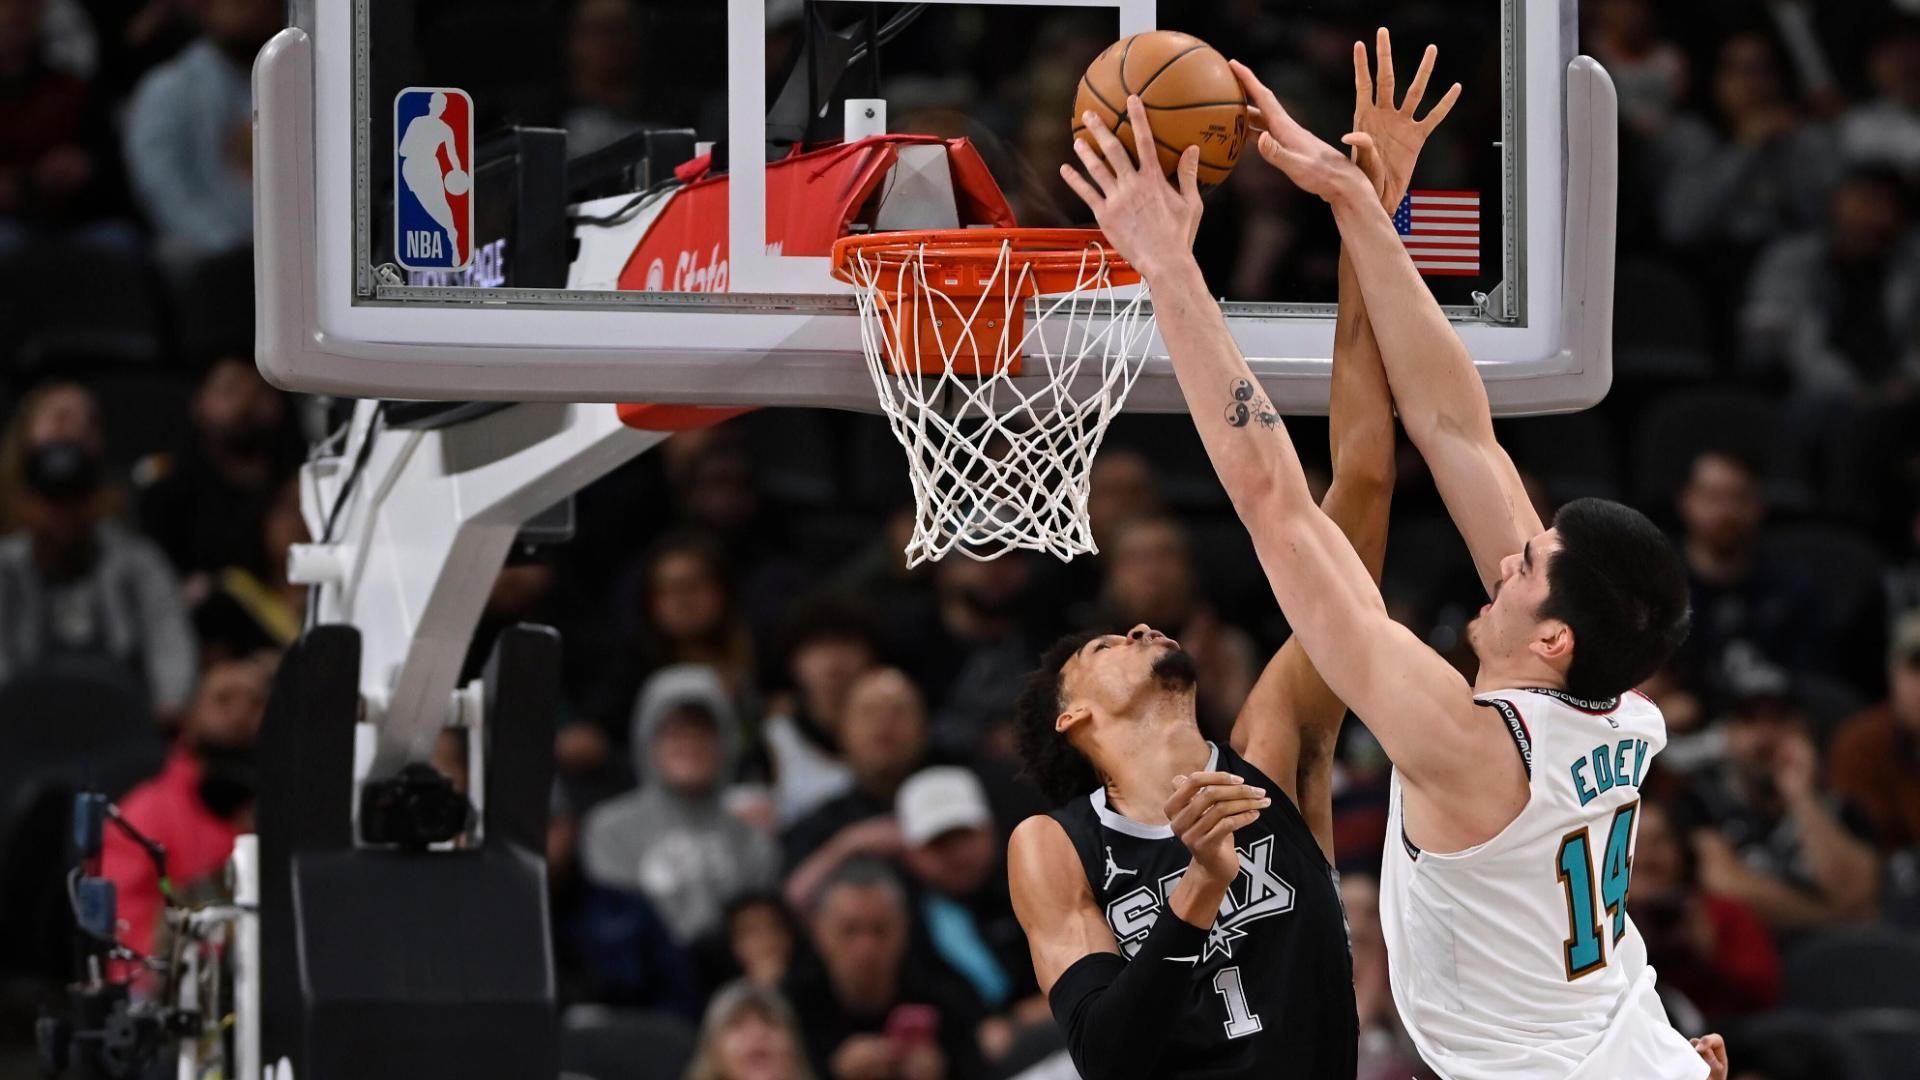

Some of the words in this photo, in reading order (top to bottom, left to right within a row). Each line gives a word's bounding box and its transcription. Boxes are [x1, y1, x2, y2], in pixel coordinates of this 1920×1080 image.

[406, 230, 443, 259] NBA
[1570, 738, 1648, 808] EDEY
[1106, 834, 1295, 963] SX
[1555, 798, 1640, 983] 14
[1213, 966, 1263, 1040] 1
